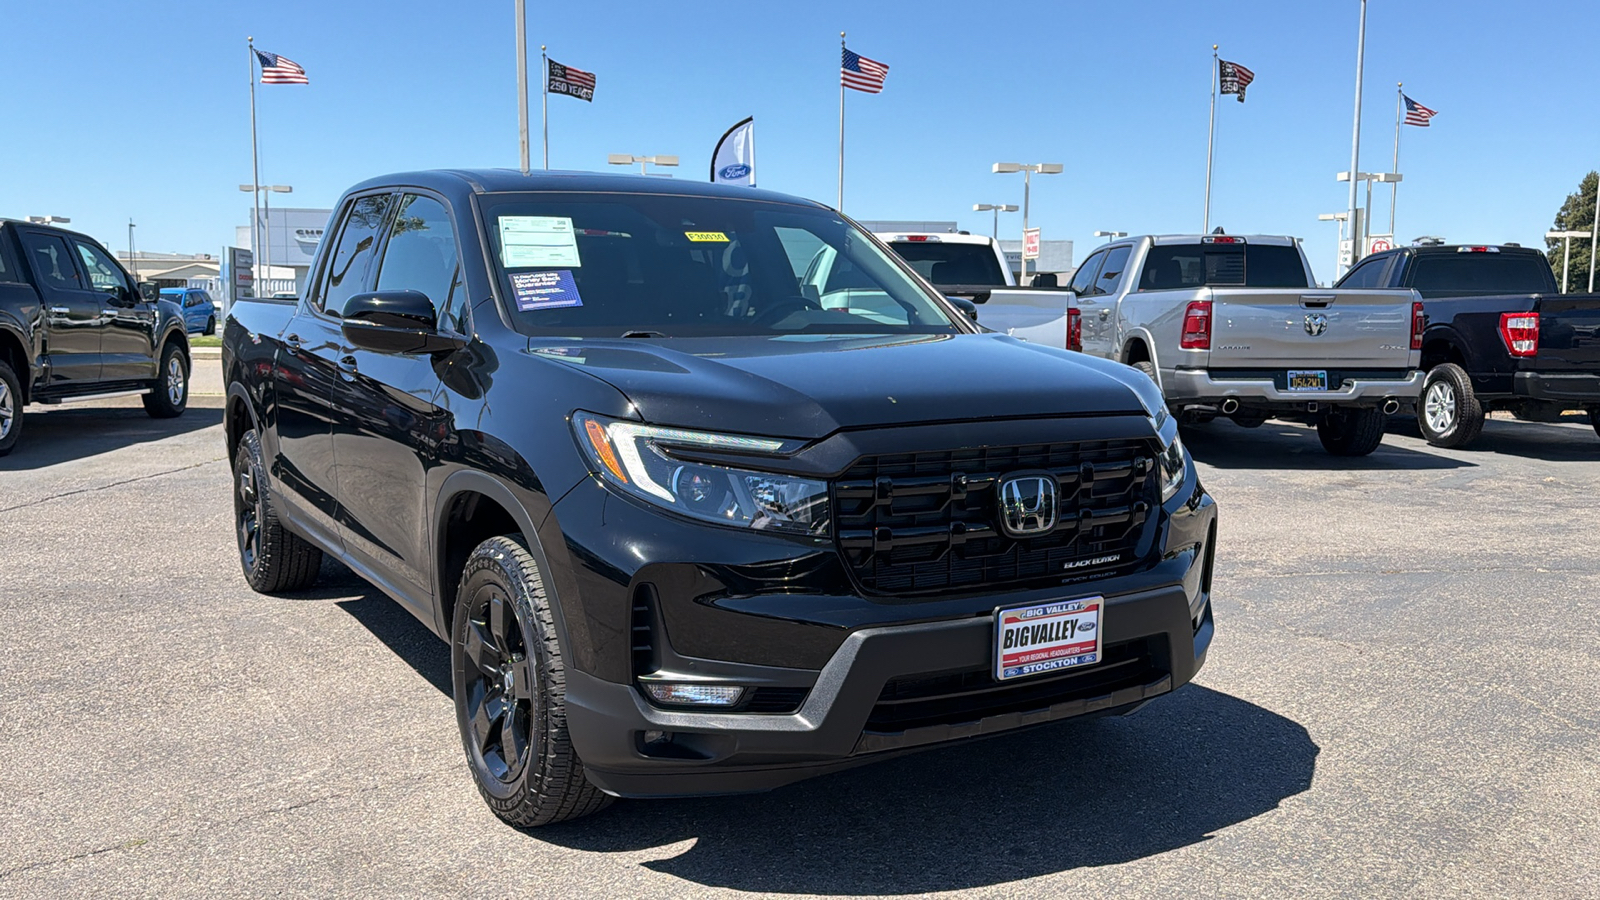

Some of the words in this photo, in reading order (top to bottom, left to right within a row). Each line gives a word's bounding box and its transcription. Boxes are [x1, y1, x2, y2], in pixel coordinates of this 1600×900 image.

[550, 81, 567, 92] 250
[1221, 82, 1239, 92] 250
[724, 165, 747, 179] Ford
[1063, 559, 1091, 570] BLACK
[1091, 553, 1121, 565] EDITION
[1026, 606, 1044, 618] BIG
[1046, 602, 1081, 615] VALLEY
[1003, 619, 1079, 650] BIGVALLEY
[1018, 654, 1031, 663] YOUR
[1030, 651, 1050, 662] REGIONAL
[1050, 646, 1081, 658] HEADQUARTERS
[1023, 656, 1078, 674] STOCKTON
